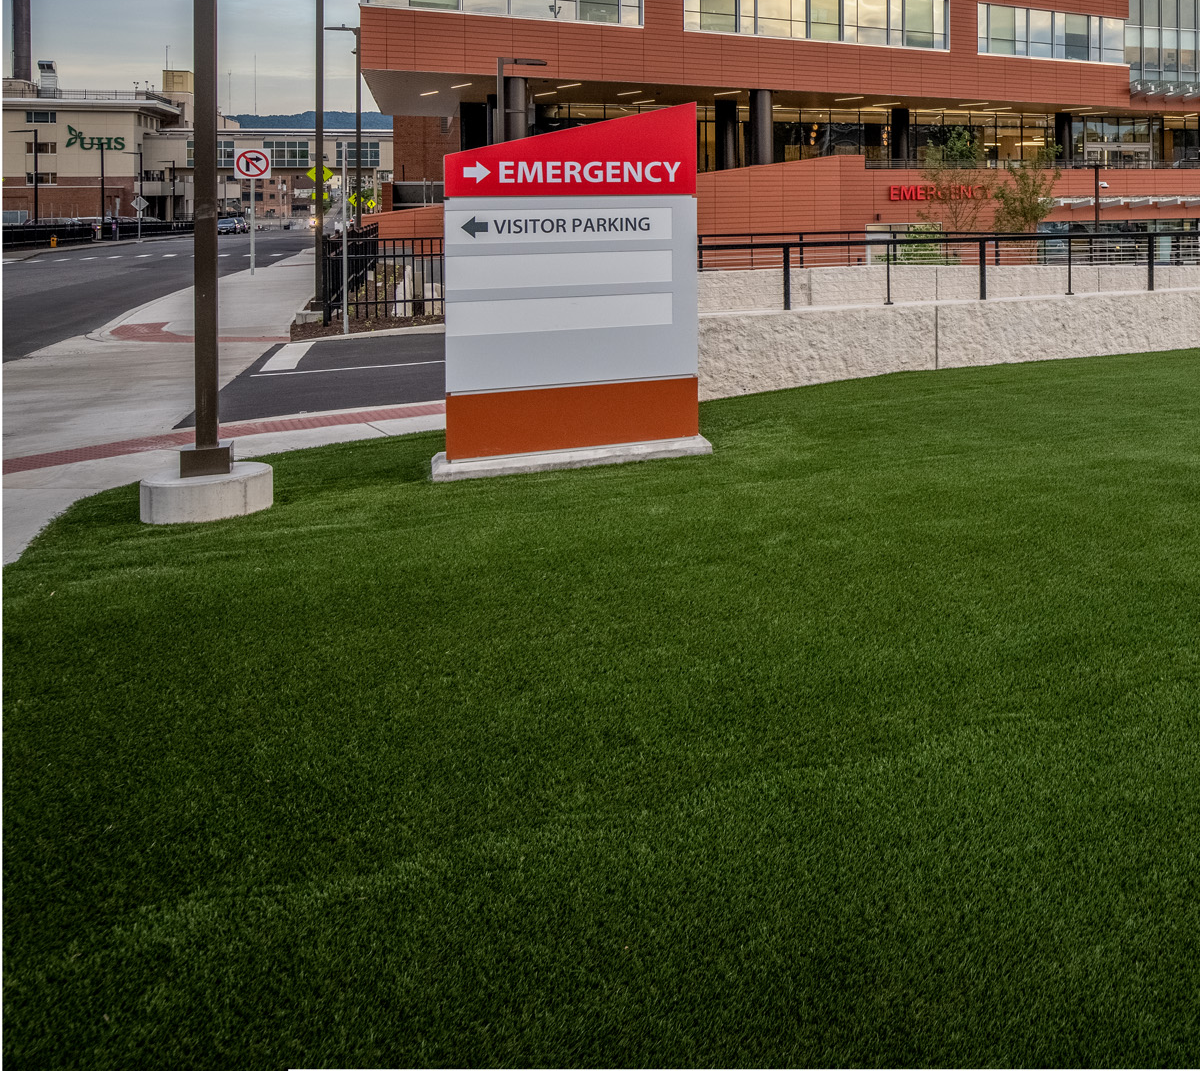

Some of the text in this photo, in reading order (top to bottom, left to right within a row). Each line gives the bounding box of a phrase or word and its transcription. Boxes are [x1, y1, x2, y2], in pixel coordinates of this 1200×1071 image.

[79, 136, 126, 151] UHS
[498, 161, 681, 184] EMERGENCY
[493, 216, 651, 235] VISITOR PARKING
